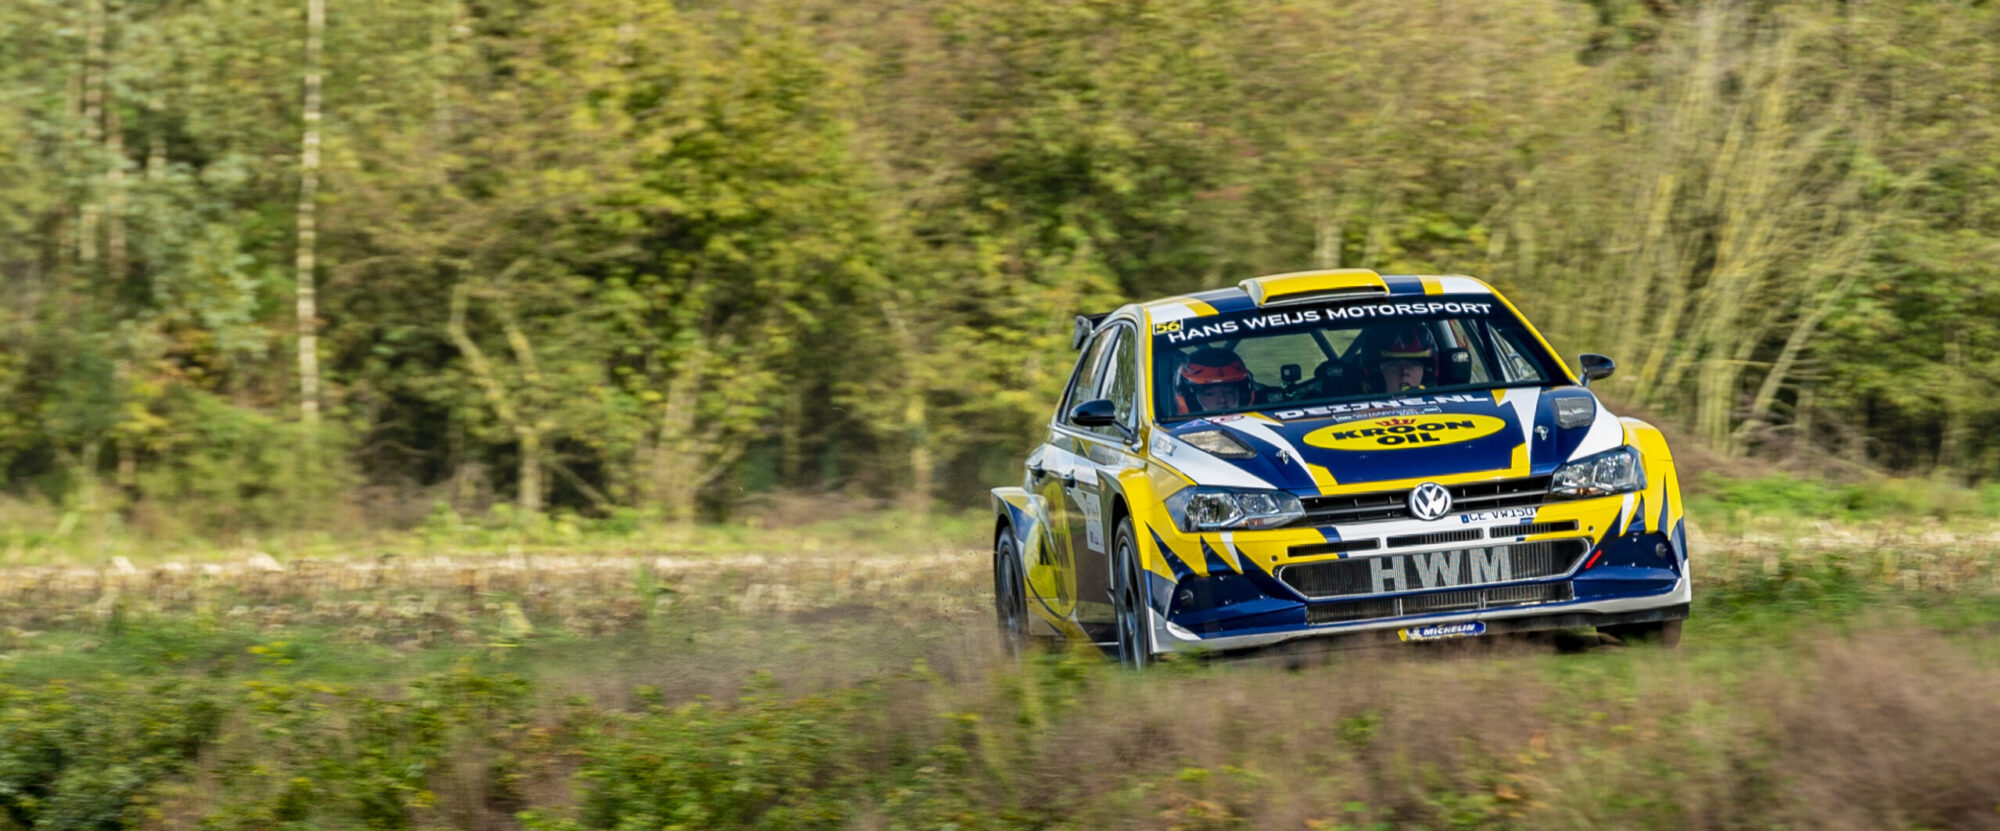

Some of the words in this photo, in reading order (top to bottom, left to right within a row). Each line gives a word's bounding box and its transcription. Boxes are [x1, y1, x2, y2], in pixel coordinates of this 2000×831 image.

[1156, 319, 1180, 334] 56
[1167, 320, 1239, 344] HANS
[1243, 310, 1321, 330] WEIJS
[1325, 302, 1491, 320] MOTORSPORT
[1332, 420, 1475, 441] KROON
[1376, 432, 1440, 446] OIL
[1369, 545, 1512, 594] HWM
[1423, 623, 1475, 636] MICHELIN
